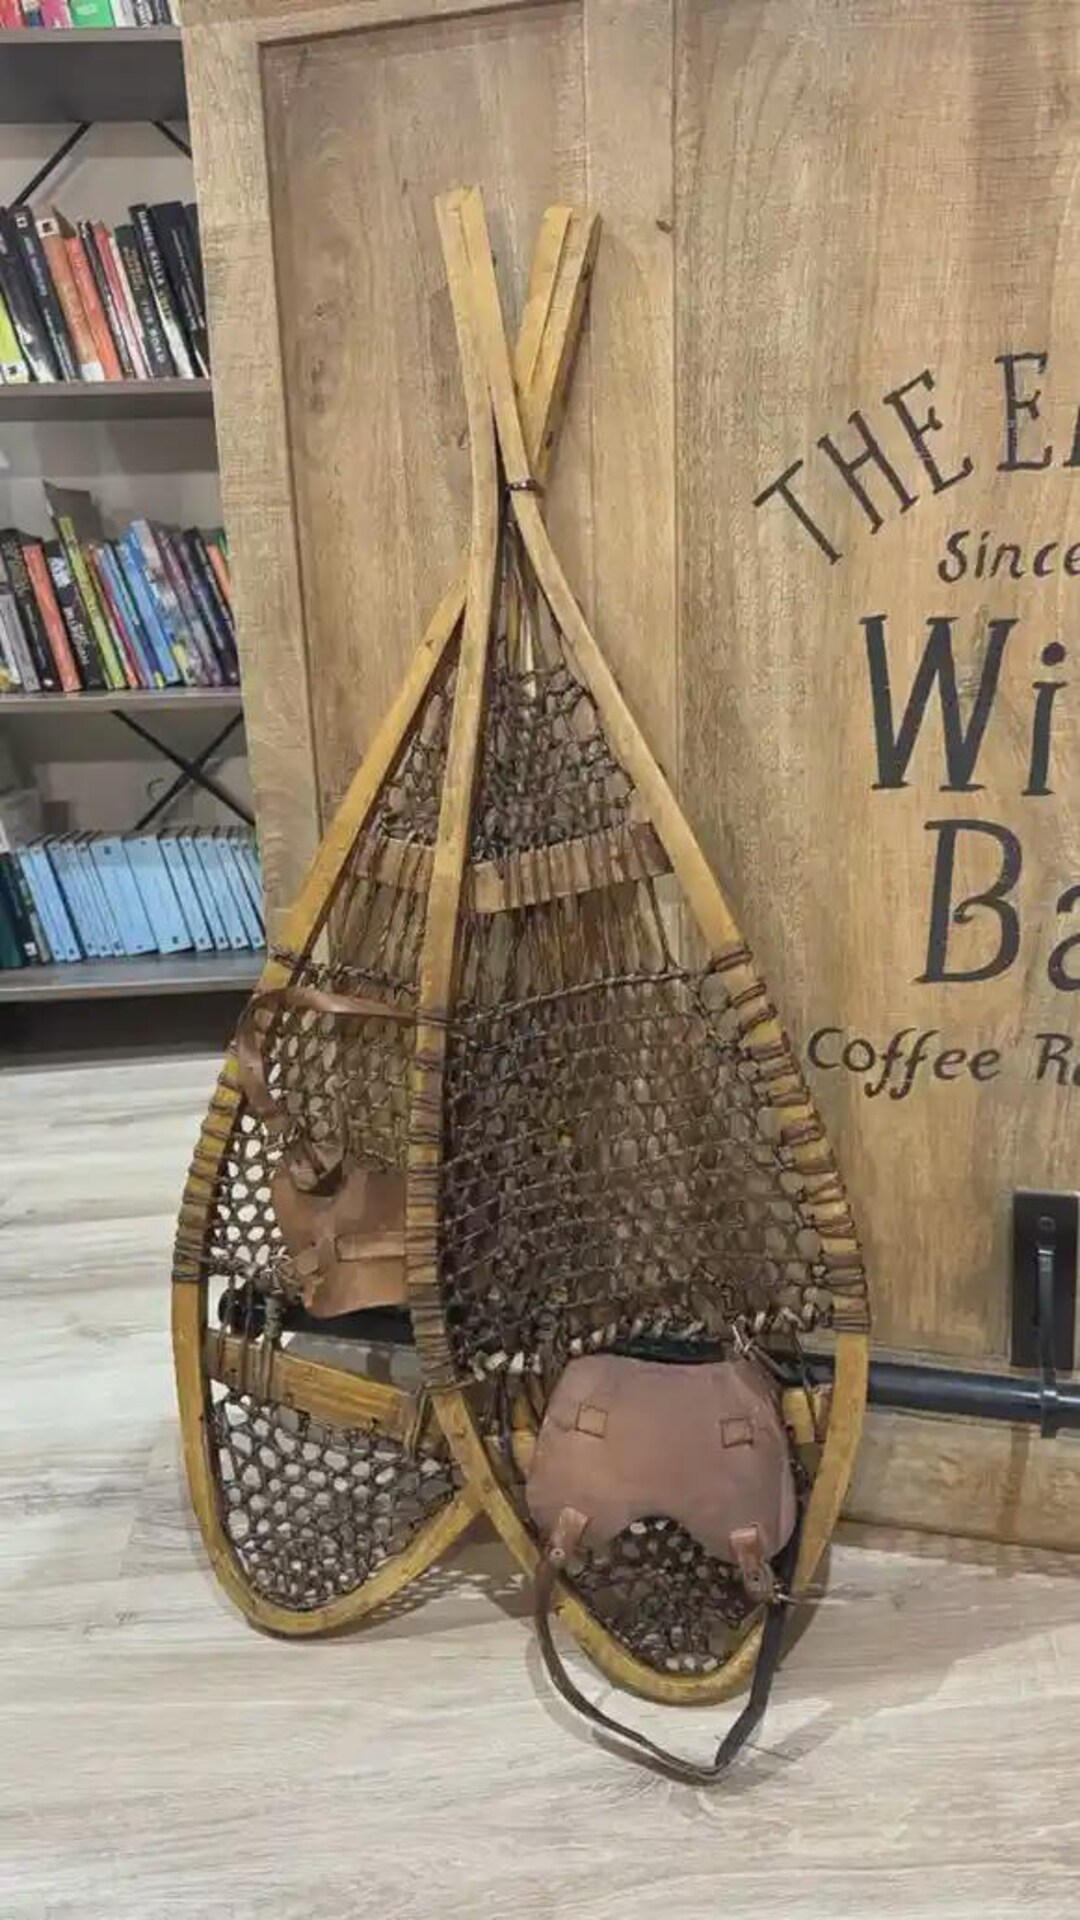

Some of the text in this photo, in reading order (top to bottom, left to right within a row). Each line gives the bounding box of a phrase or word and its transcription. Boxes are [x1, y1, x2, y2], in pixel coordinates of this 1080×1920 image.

[753, 352, 1080, 566] THE E
[858, 614, 1070, 796] Wi
[807, 1025, 1002, 1102] Coffee
